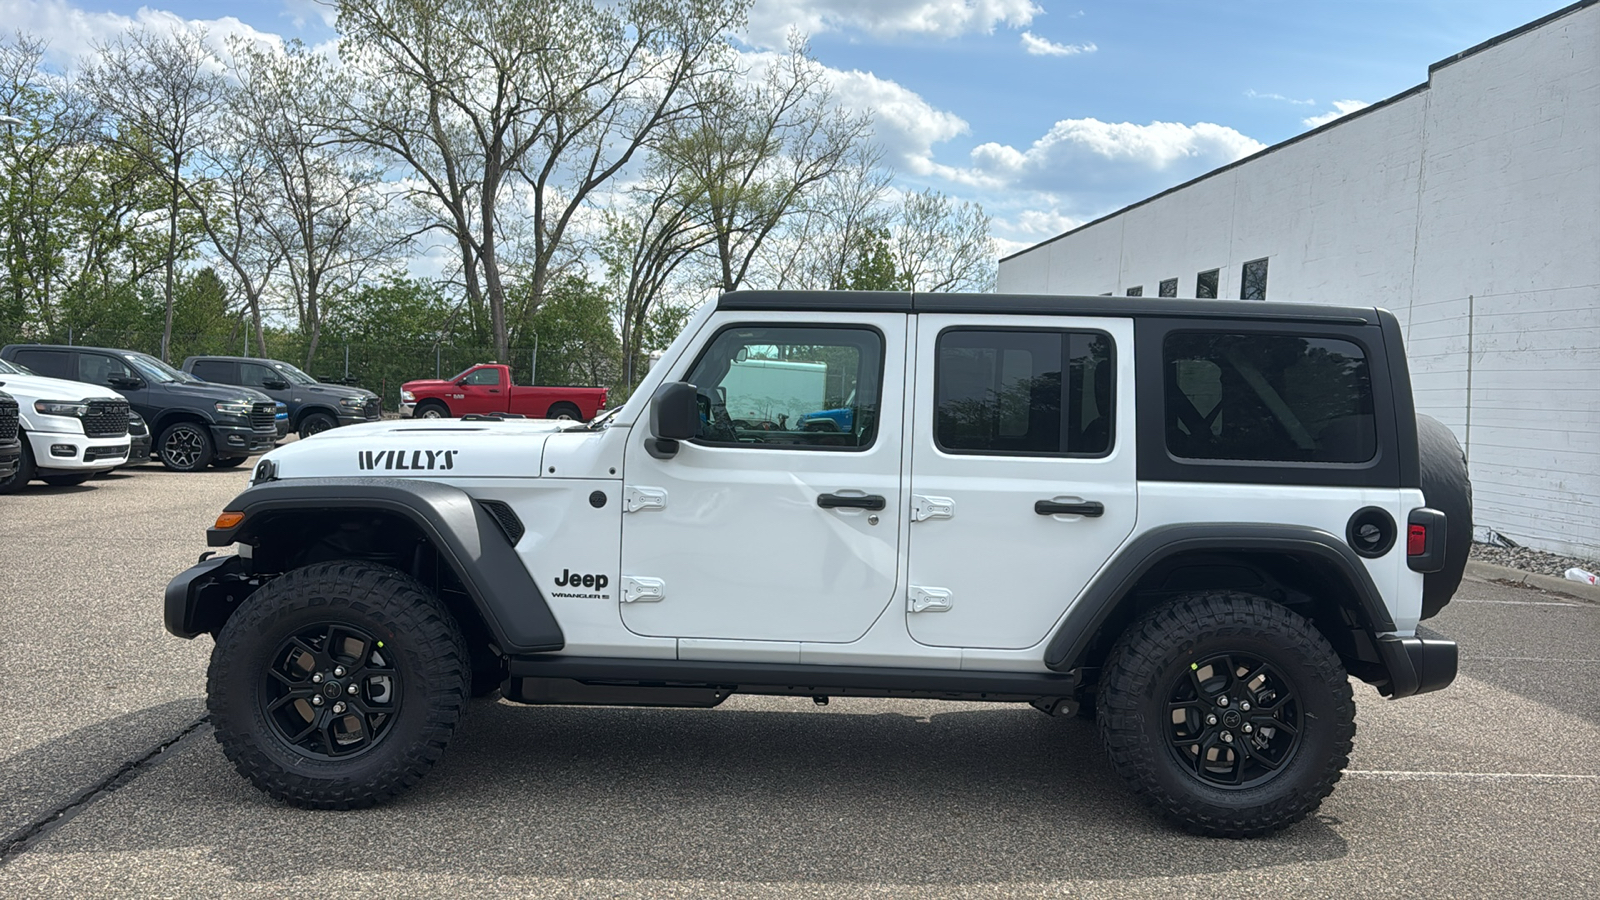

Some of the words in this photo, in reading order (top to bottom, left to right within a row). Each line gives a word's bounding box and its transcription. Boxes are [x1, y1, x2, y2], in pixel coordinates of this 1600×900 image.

[104, 406, 127, 415] RAM
[358, 450, 458, 470] WILLYS
[554, 569, 609, 591] Jeep
